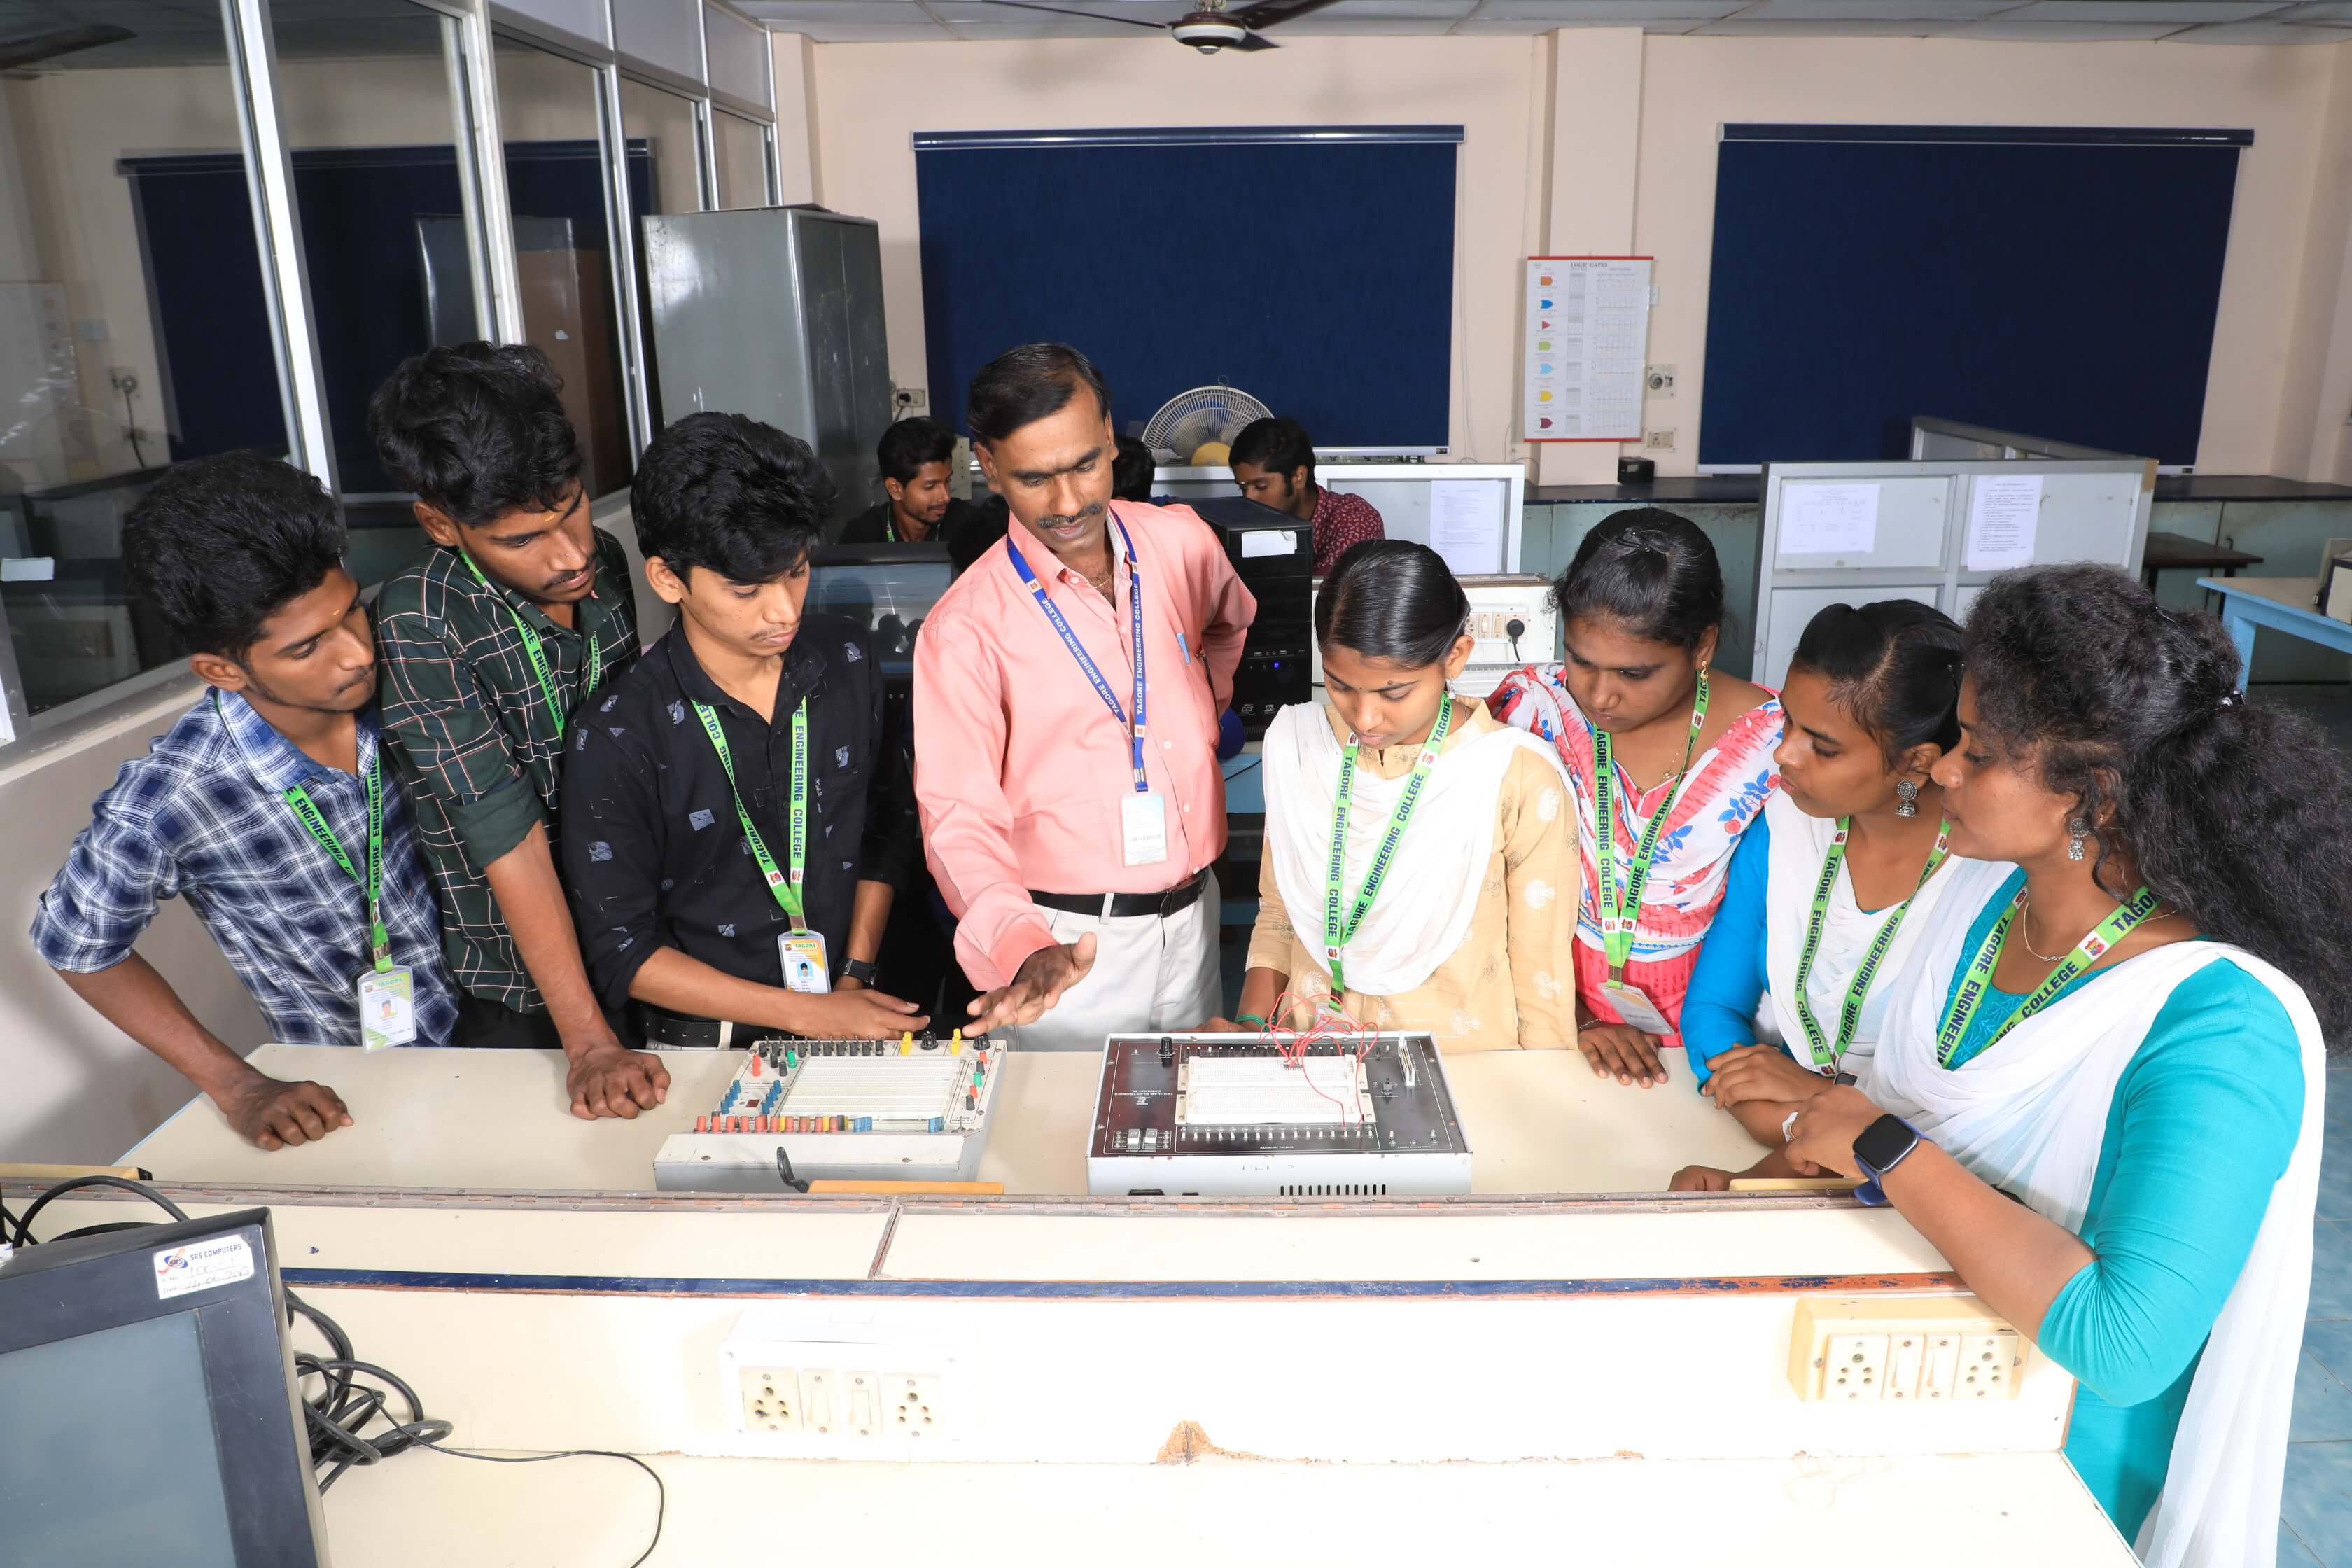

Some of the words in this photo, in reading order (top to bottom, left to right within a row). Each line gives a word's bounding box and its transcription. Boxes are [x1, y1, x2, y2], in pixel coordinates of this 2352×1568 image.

[1042, 598, 1066, 632] COLLEGE
[1064, 633, 1100, 684] ENGINEERING
[533, 649, 562, 723] ENGINEERING
[1098, 684, 1119, 714] TAGORE
[697, 702, 720, 739] COLLE
[1432, 700, 1450, 743] TAGORE
[794, 725, 804, 802] ENGINEERING
[1339, 755, 1353, 800] TAGORE
[370, 760, 380, 837] ENGINEERIN
[1598, 776, 1609, 850] ENGINEERING
[294, 797, 345, 861] ENGINEERING
[746, 824, 770, 864] TAGORE
[793, 808, 803, 858] COLLEGE
[1329, 806, 1346, 881] ENGINEERING
[1626, 865, 1644, 909] TAGORE
[1638, 789, 1674, 860] ENGINEERING
[1345, 901, 1368, 938] TAGORE
[1365, 826, 1401, 897] ENGINEERING
[1396, 773, 1425, 822] COLLEGE
[1816, 855, 1838, 902] TAGORE
[1600, 858, 1613, 908] COLLEGE
[1328, 888, 1338, 937] COLLEGE
[2111, 891, 2157, 932] TAGO
[1796, 910, 1822, 992] ENGINEERING
[1975, 916, 2009, 974] TAGORE
[1840, 1001, 1858, 1044] TAGORE
[1853, 916, 1898, 997] ENGINEERING
[2021, 961, 2079, 1018] COLLEGE
[1797, 1000, 1824, 1054] COLLEGE
[1938, 980, 1982, 1064] ENGINEERI
[169, 1257, 183, 1266] SRS
[204, 1243, 241, 1258] COMPUTERS
